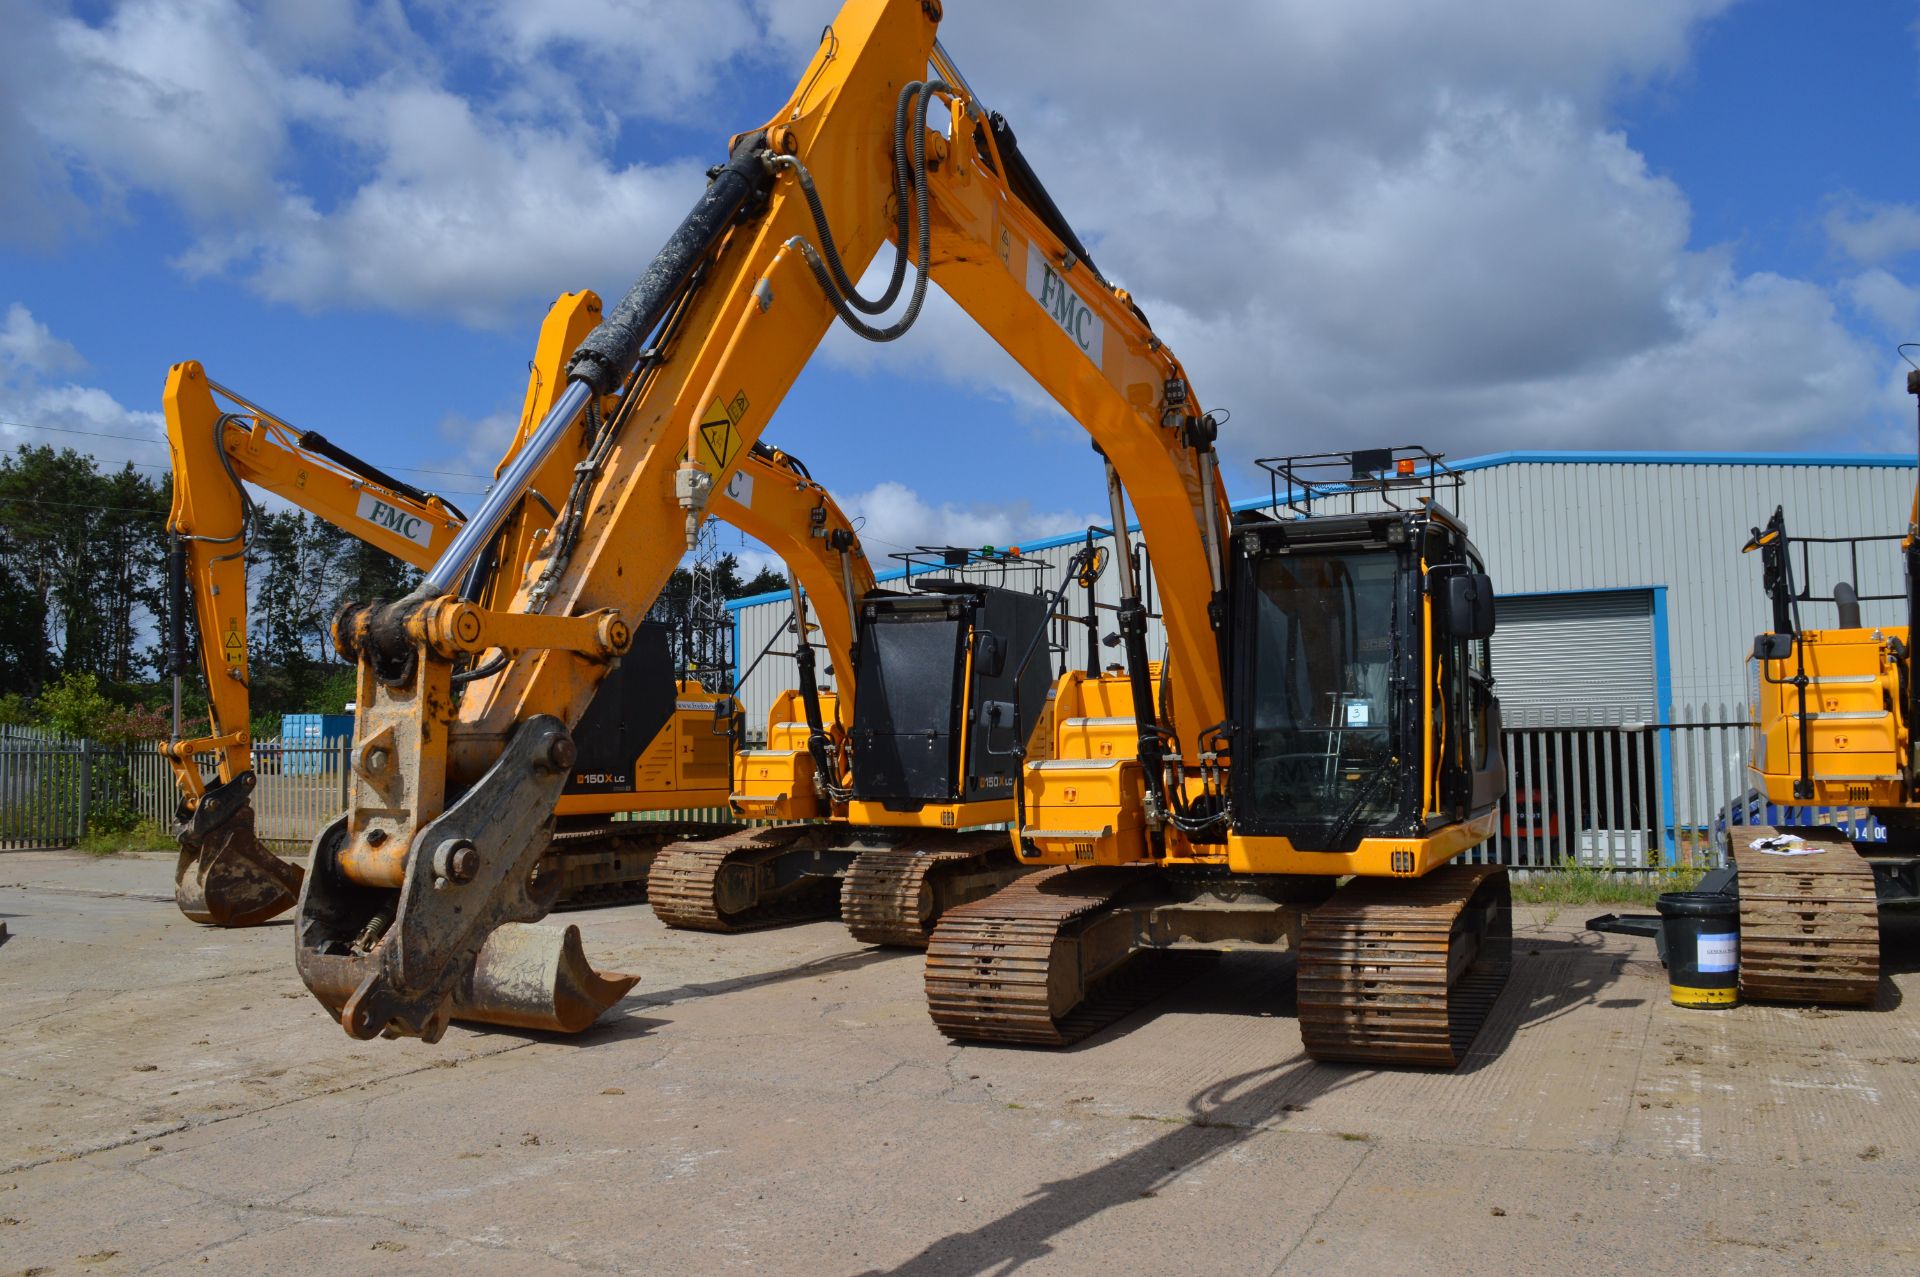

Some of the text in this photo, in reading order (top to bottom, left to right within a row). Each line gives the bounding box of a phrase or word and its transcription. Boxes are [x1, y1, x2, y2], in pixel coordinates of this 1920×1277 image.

[1039, 262, 1092, 351] FMC
[368, 500, 422, 539] FMC
[1352, 708, 1361, 719] 3
[614, 775, 625, 783] LC
[1005, 777, 1013, 786] LC
